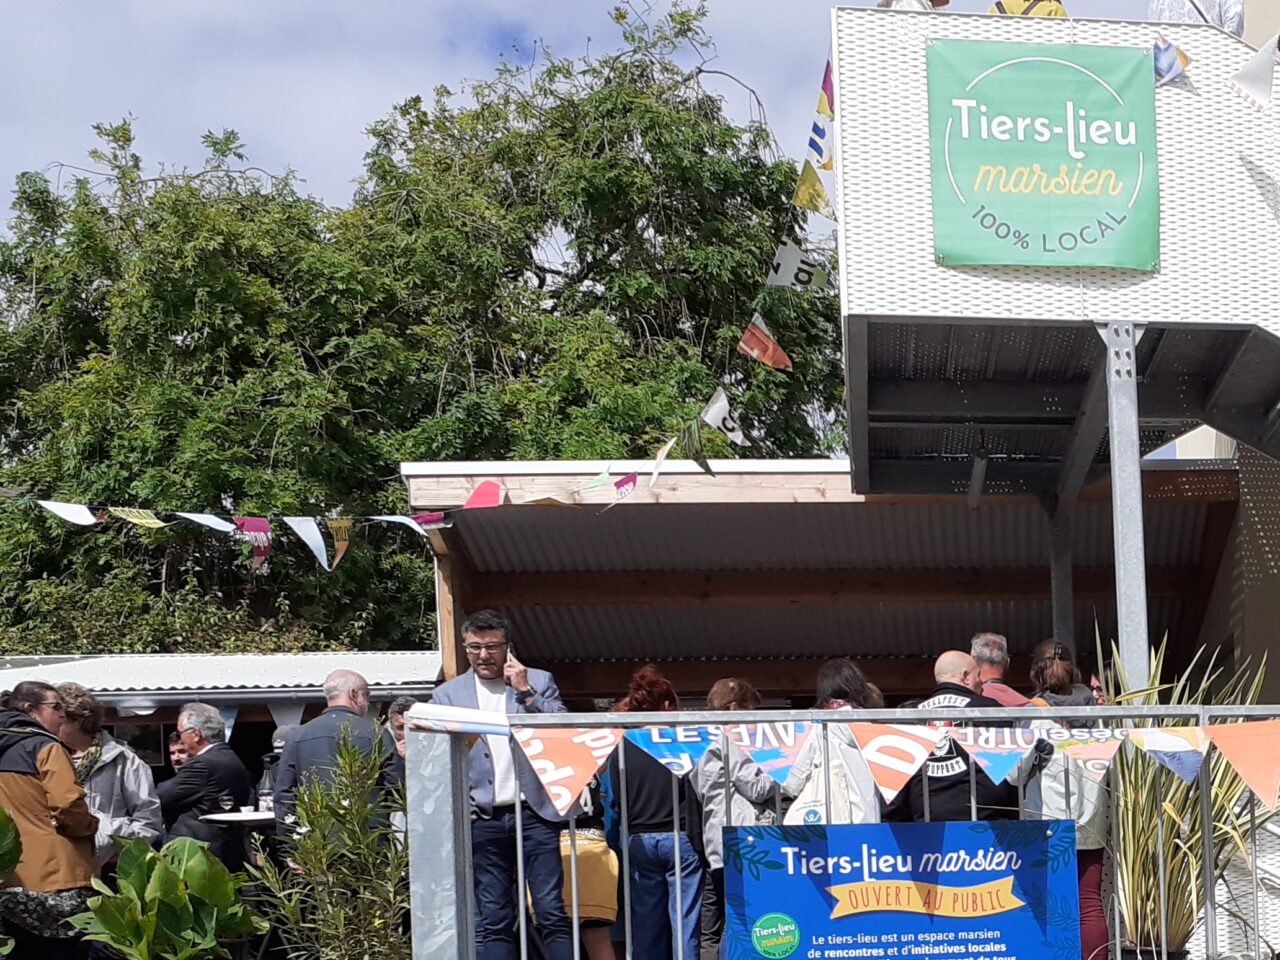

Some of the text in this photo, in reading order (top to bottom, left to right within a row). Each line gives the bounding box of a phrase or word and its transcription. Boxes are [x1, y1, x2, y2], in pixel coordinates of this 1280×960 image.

[952, 99, 1136, 159] Tiers-lieu
[974, 163, 1123, 196] marsien
[971, 205, 1127, 253] 100% LOCAL
[780, 844, 1022, 882] Tiers-lieu marsien
[848, 885, 1006, 913] OUVERT AU PUBLIC
[753, 923, 795, 937] Tiers-lieu
[812, 928, 1001, 945] Le tiers-lieu est un espace marsien
[807, 942, 1007, 959] de rencontres et d'initiatives locales
